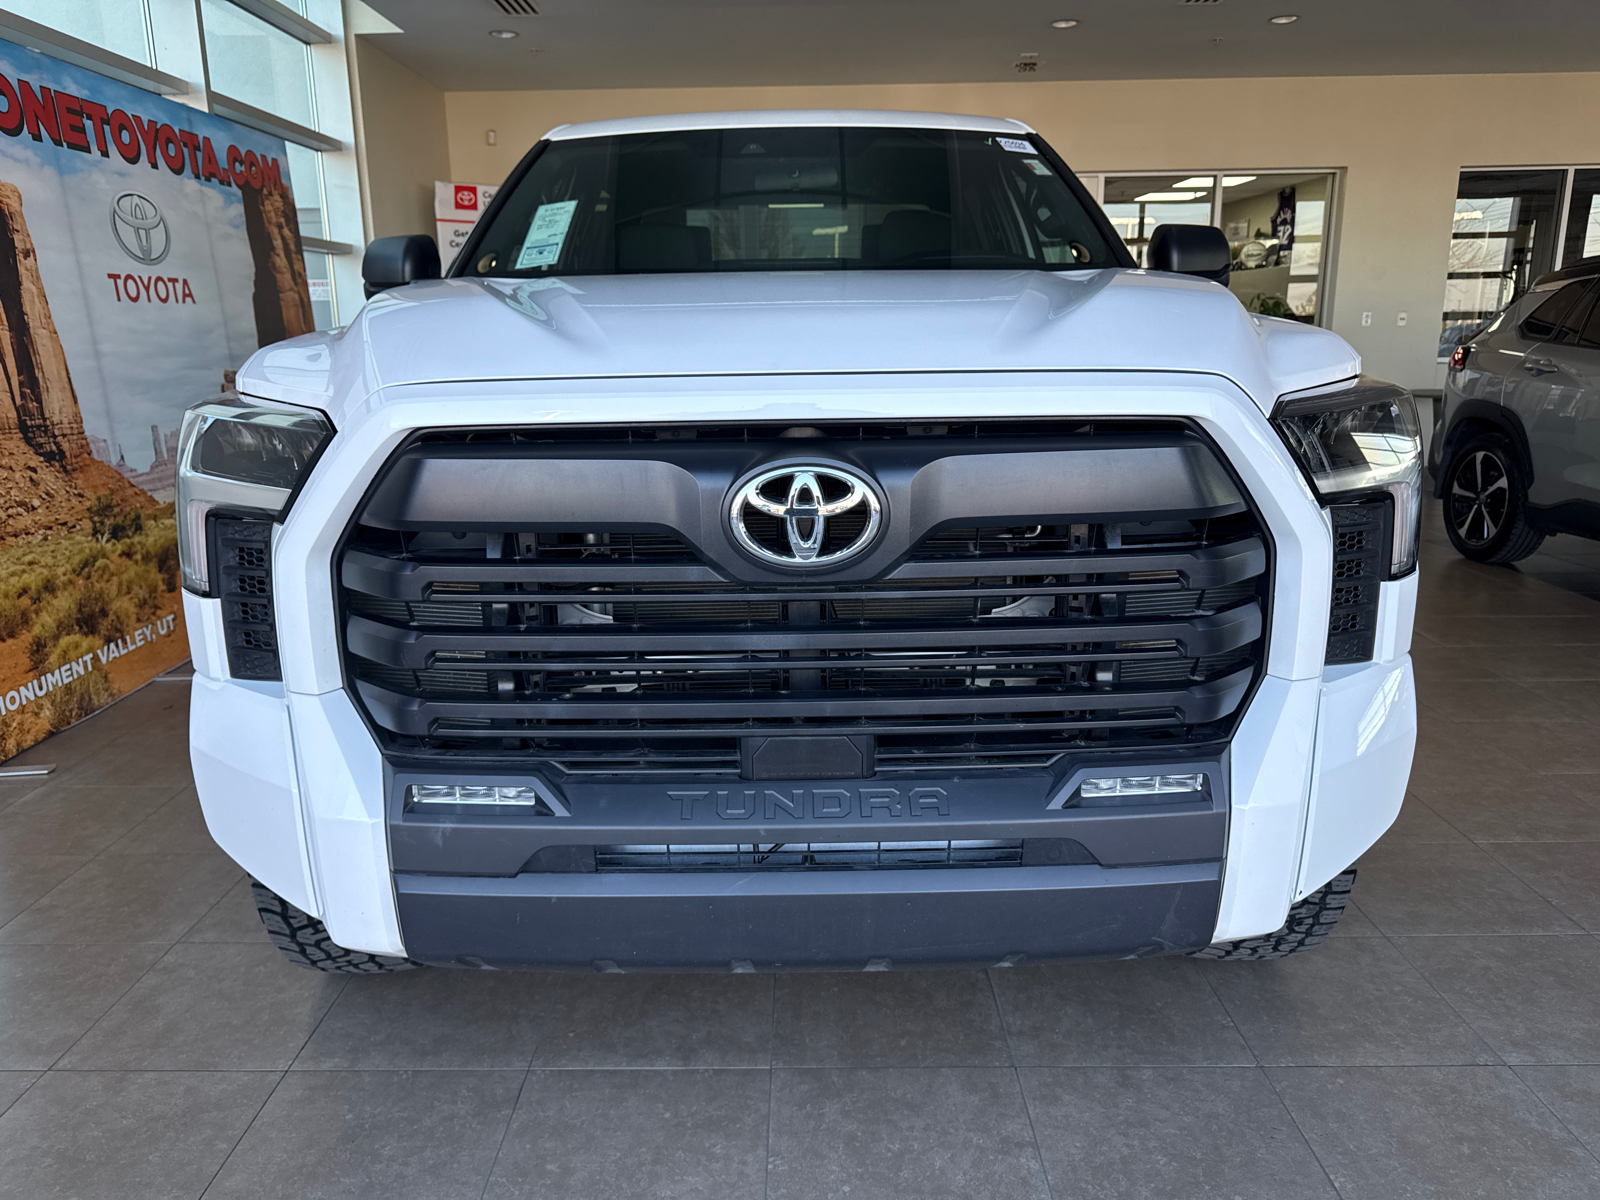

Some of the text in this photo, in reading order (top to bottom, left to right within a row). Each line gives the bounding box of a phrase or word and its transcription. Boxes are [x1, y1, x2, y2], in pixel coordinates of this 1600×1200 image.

[0, 73, 284, 192] ONETOYOTA.COM
[107, 272, 196, 304] TOYOTA
[96, 624, 157, 665] VALLEY,
[157, 613, 175, 636] UT
[666, 786, 950, 821] TUNDRA
